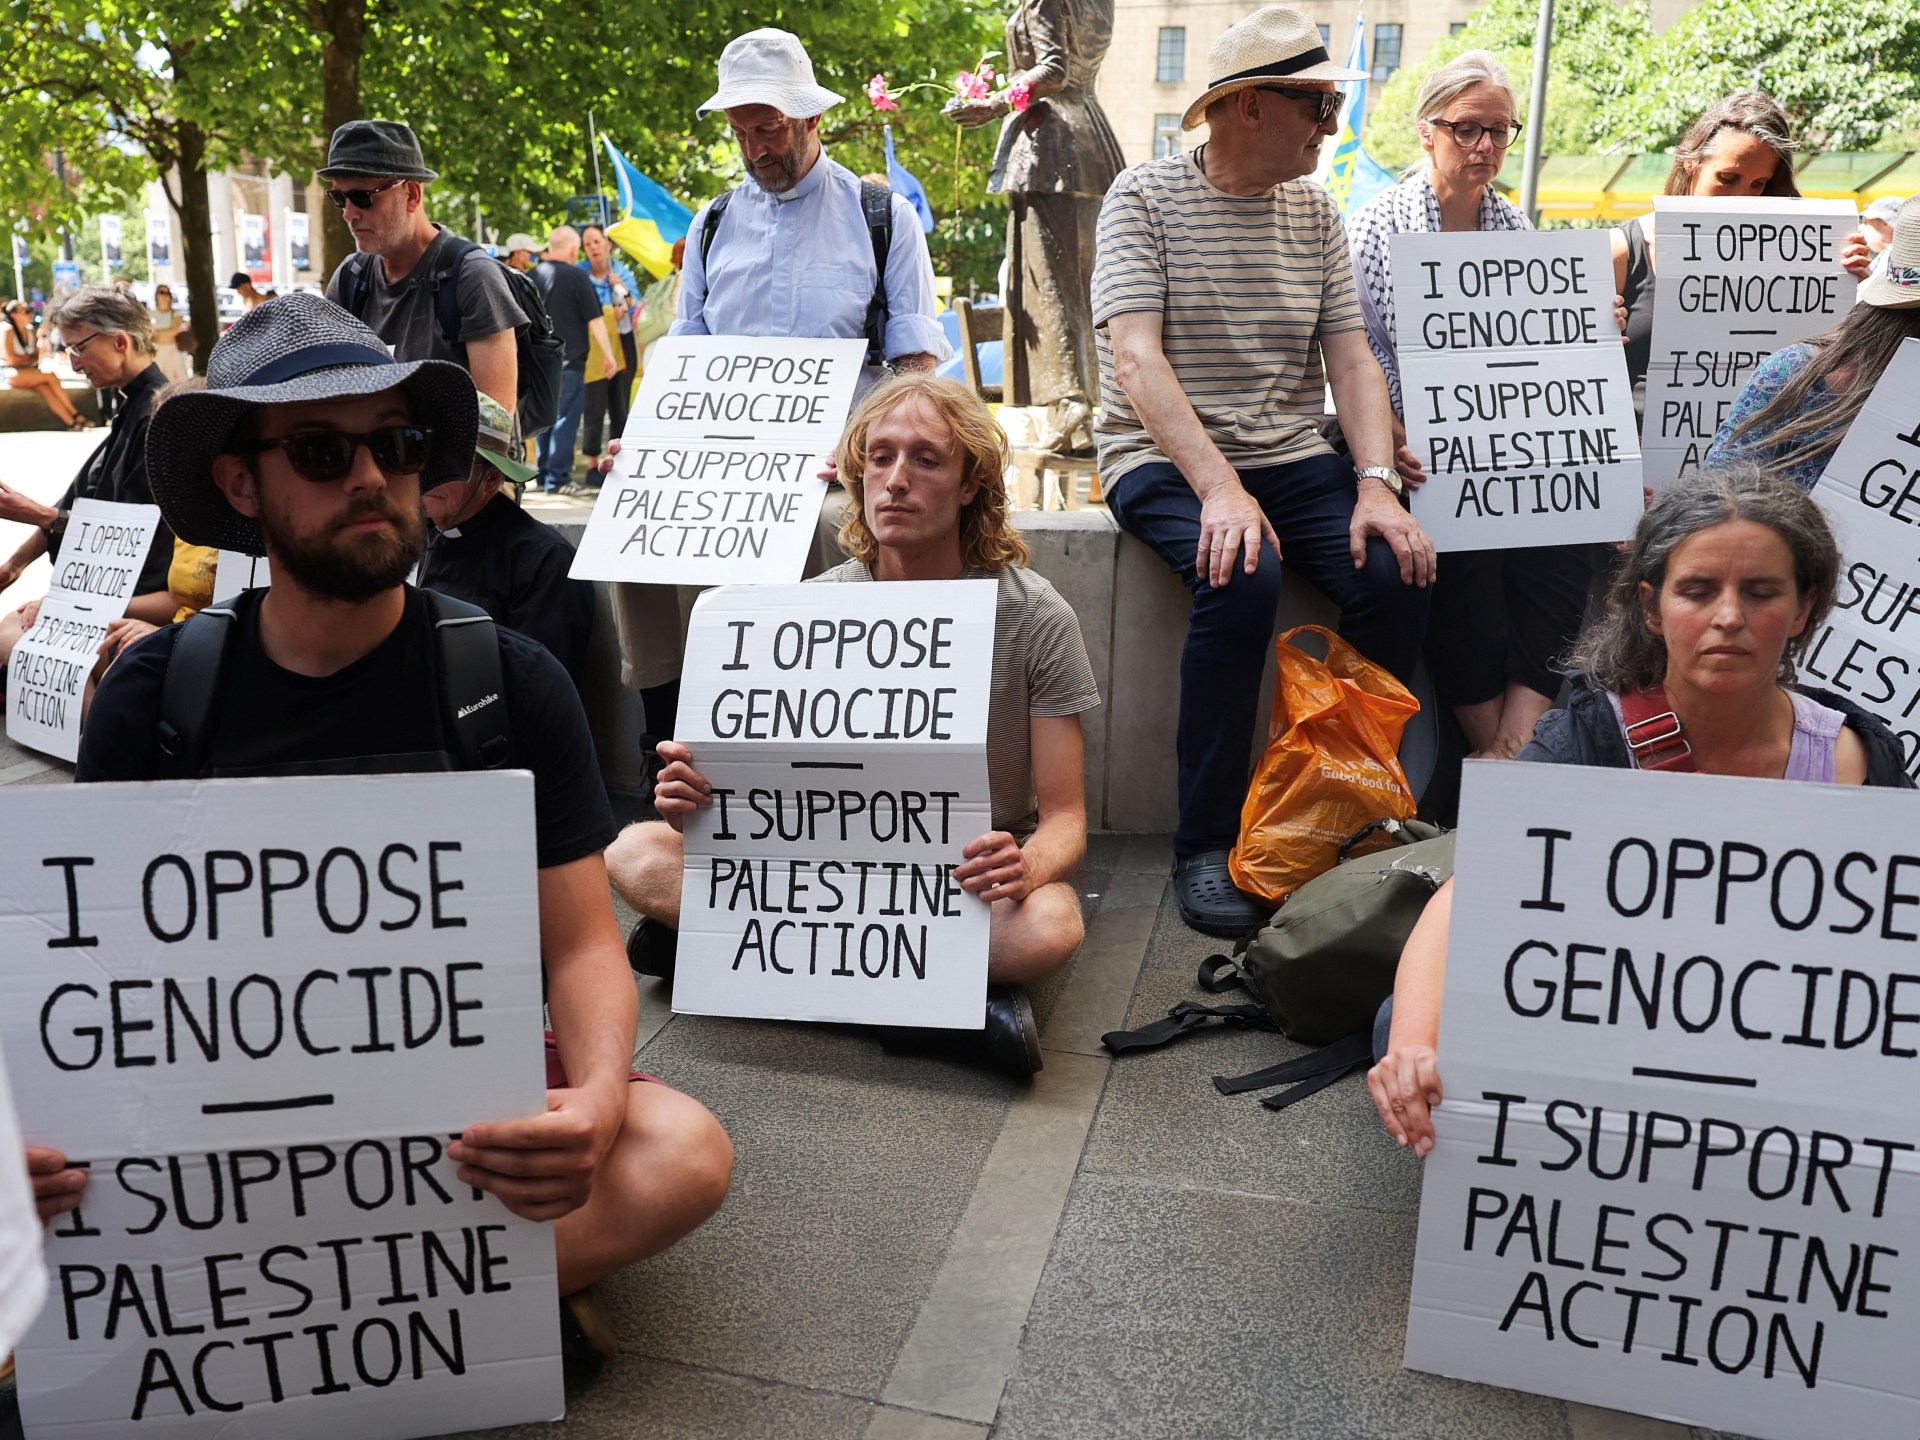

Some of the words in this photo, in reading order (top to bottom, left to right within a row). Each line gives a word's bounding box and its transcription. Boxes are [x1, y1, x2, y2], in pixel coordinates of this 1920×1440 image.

[1683, 223, 1701, 261] I
[1716, 224, 1832, 262] OPPOSE
[1421, 262, 1443, 299] I
[1459, 257, 1588, 298] OPPOSE
[1679, 275, 1838, 314] GENOCIDE
[1423, 307, 1598, 349] GENOCIDE
[670, 356, 695, 381] I
[706, 356, 833, 385] OPPOSE
[1667, 351, 1688, 387] I
[656, 392, 829, 423] GENOCIDE
[1424, 386, 1447, 424] I
[1454, 378, 1608, 422] SUPPORT
[629, 449, 656, 478] I
[656, 450, 815, 482] SUPPORT
[1429, 428, 1621, 475] PALESTINE
[613, 489, 802, 522] PALESTINE
[1455, 471, 1600, 518] ACTION
[74, 523, 90, 551] I
[91, 525, 145, 558] OPPOSE
[620, 525, 768, 558] ACTION
[61, 562, 132, 599] GENOCIDE
[29, 616, 50, 643] I
[722, 621, 755, 670] I
[774, 618, 953, 670] OPPOSE
[13, 651, 83, 696] PALESTINE
[17, 687, 67, 731] ACTION
[466, 694, 499, 713] Eurohike
[711, 688, 957, 740] GENOCIDE
[711, 787, 738, 841] I
[749, 790, 960, 845] SUPPORT
[42, 857, 99, 949] I
[142, 841, 467, 943] OPPOSE
[709, 858, 963, 919] PALESTINE
[1520, 828, 1572, 912] I
[1607, 837, 1920, 942] OPPOSE
[732, 919, 927, 980] ACTION
[40, 962, 484, 1071] GENOCIDE
[1504, 939, 1920, 1059] GENOCIDE
[1477, 1090, 1527, 1167] I
[1540, 1099, 1915, 1218] SUPPORT
[1463, 1186, 1898, 1318] PALESTINE
[57, 1223, 512, 1341] PALESTINE
[1499, 1271, 1825, 1389] ACTION
[130, 1306, 467, 1422] ACTION
